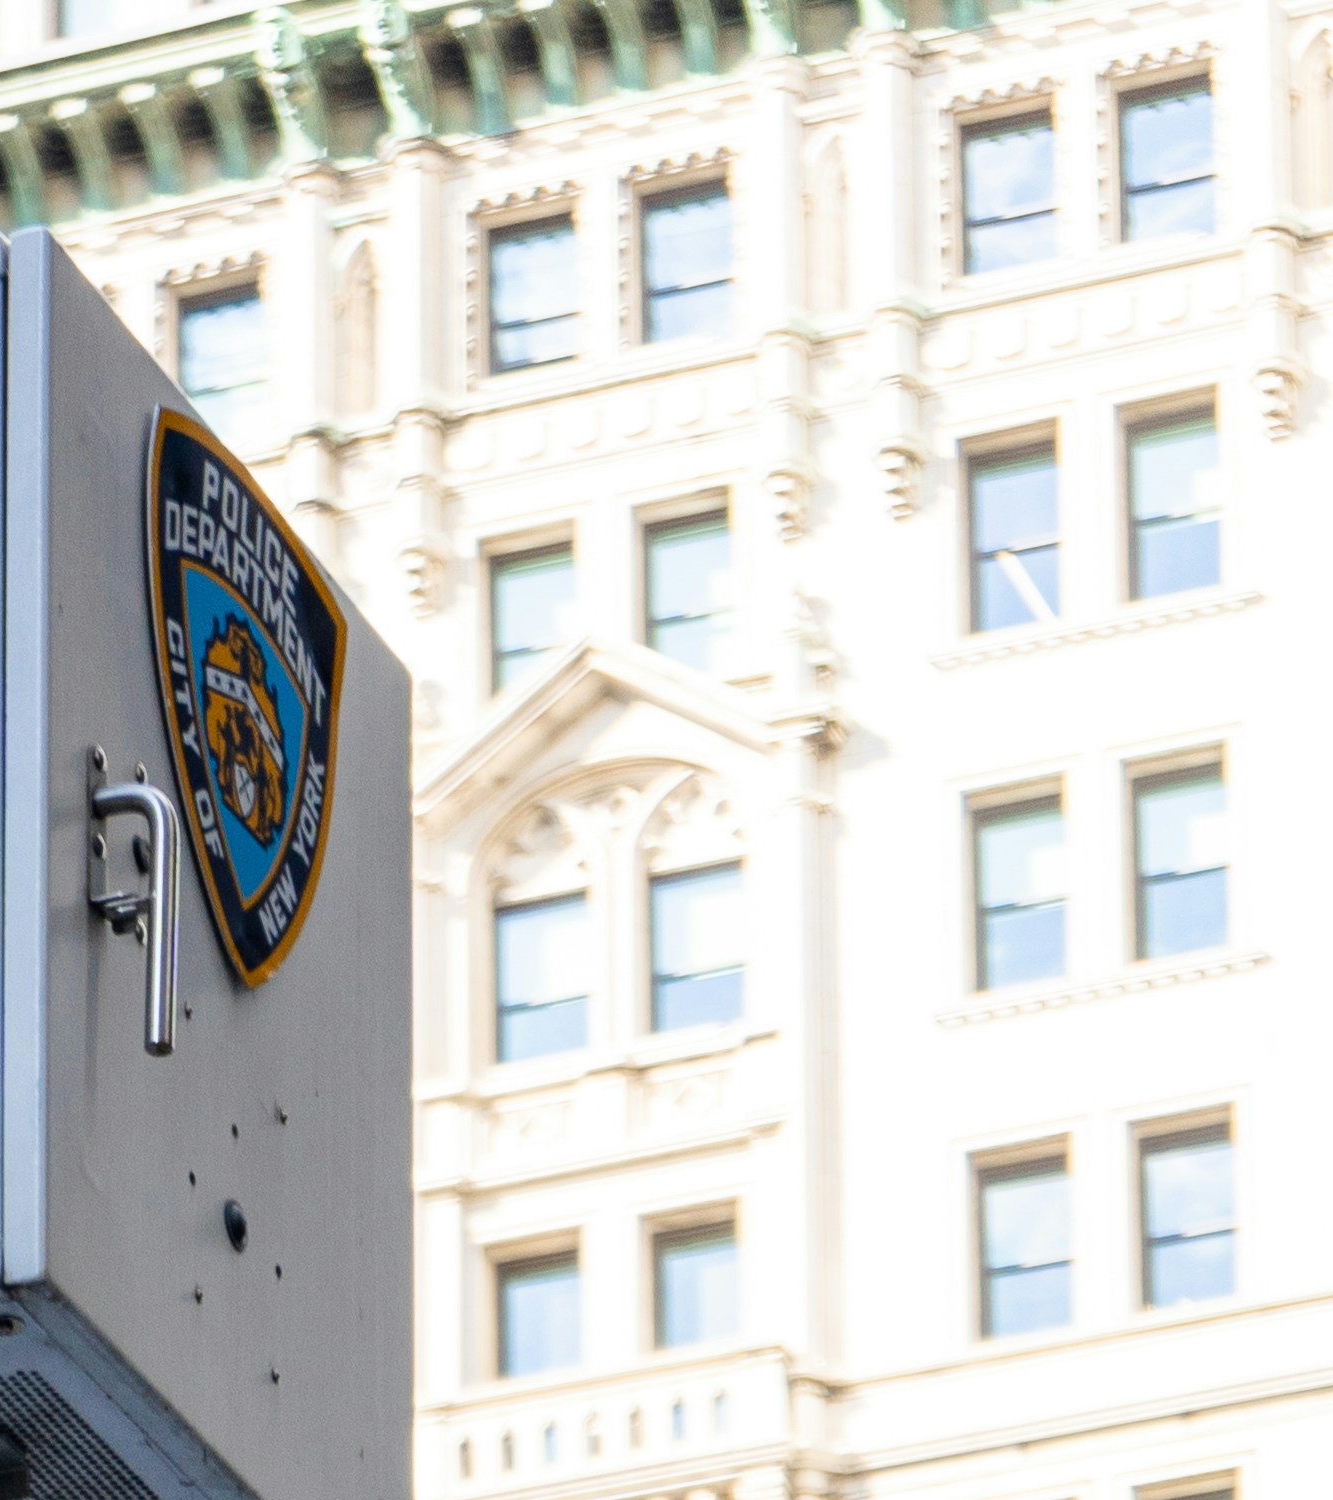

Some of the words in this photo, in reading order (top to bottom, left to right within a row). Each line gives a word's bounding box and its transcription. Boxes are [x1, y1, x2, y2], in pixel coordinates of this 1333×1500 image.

[164, 499, 325, 727] DEPARTMENT
[201, 459, 298, 616] POLICE
[166, 617, 200, 758] CITY
[194, 789, 225, 859] OF
[258, 872, 298, 949] NEW
[292, 750, 325, 867] YORK
